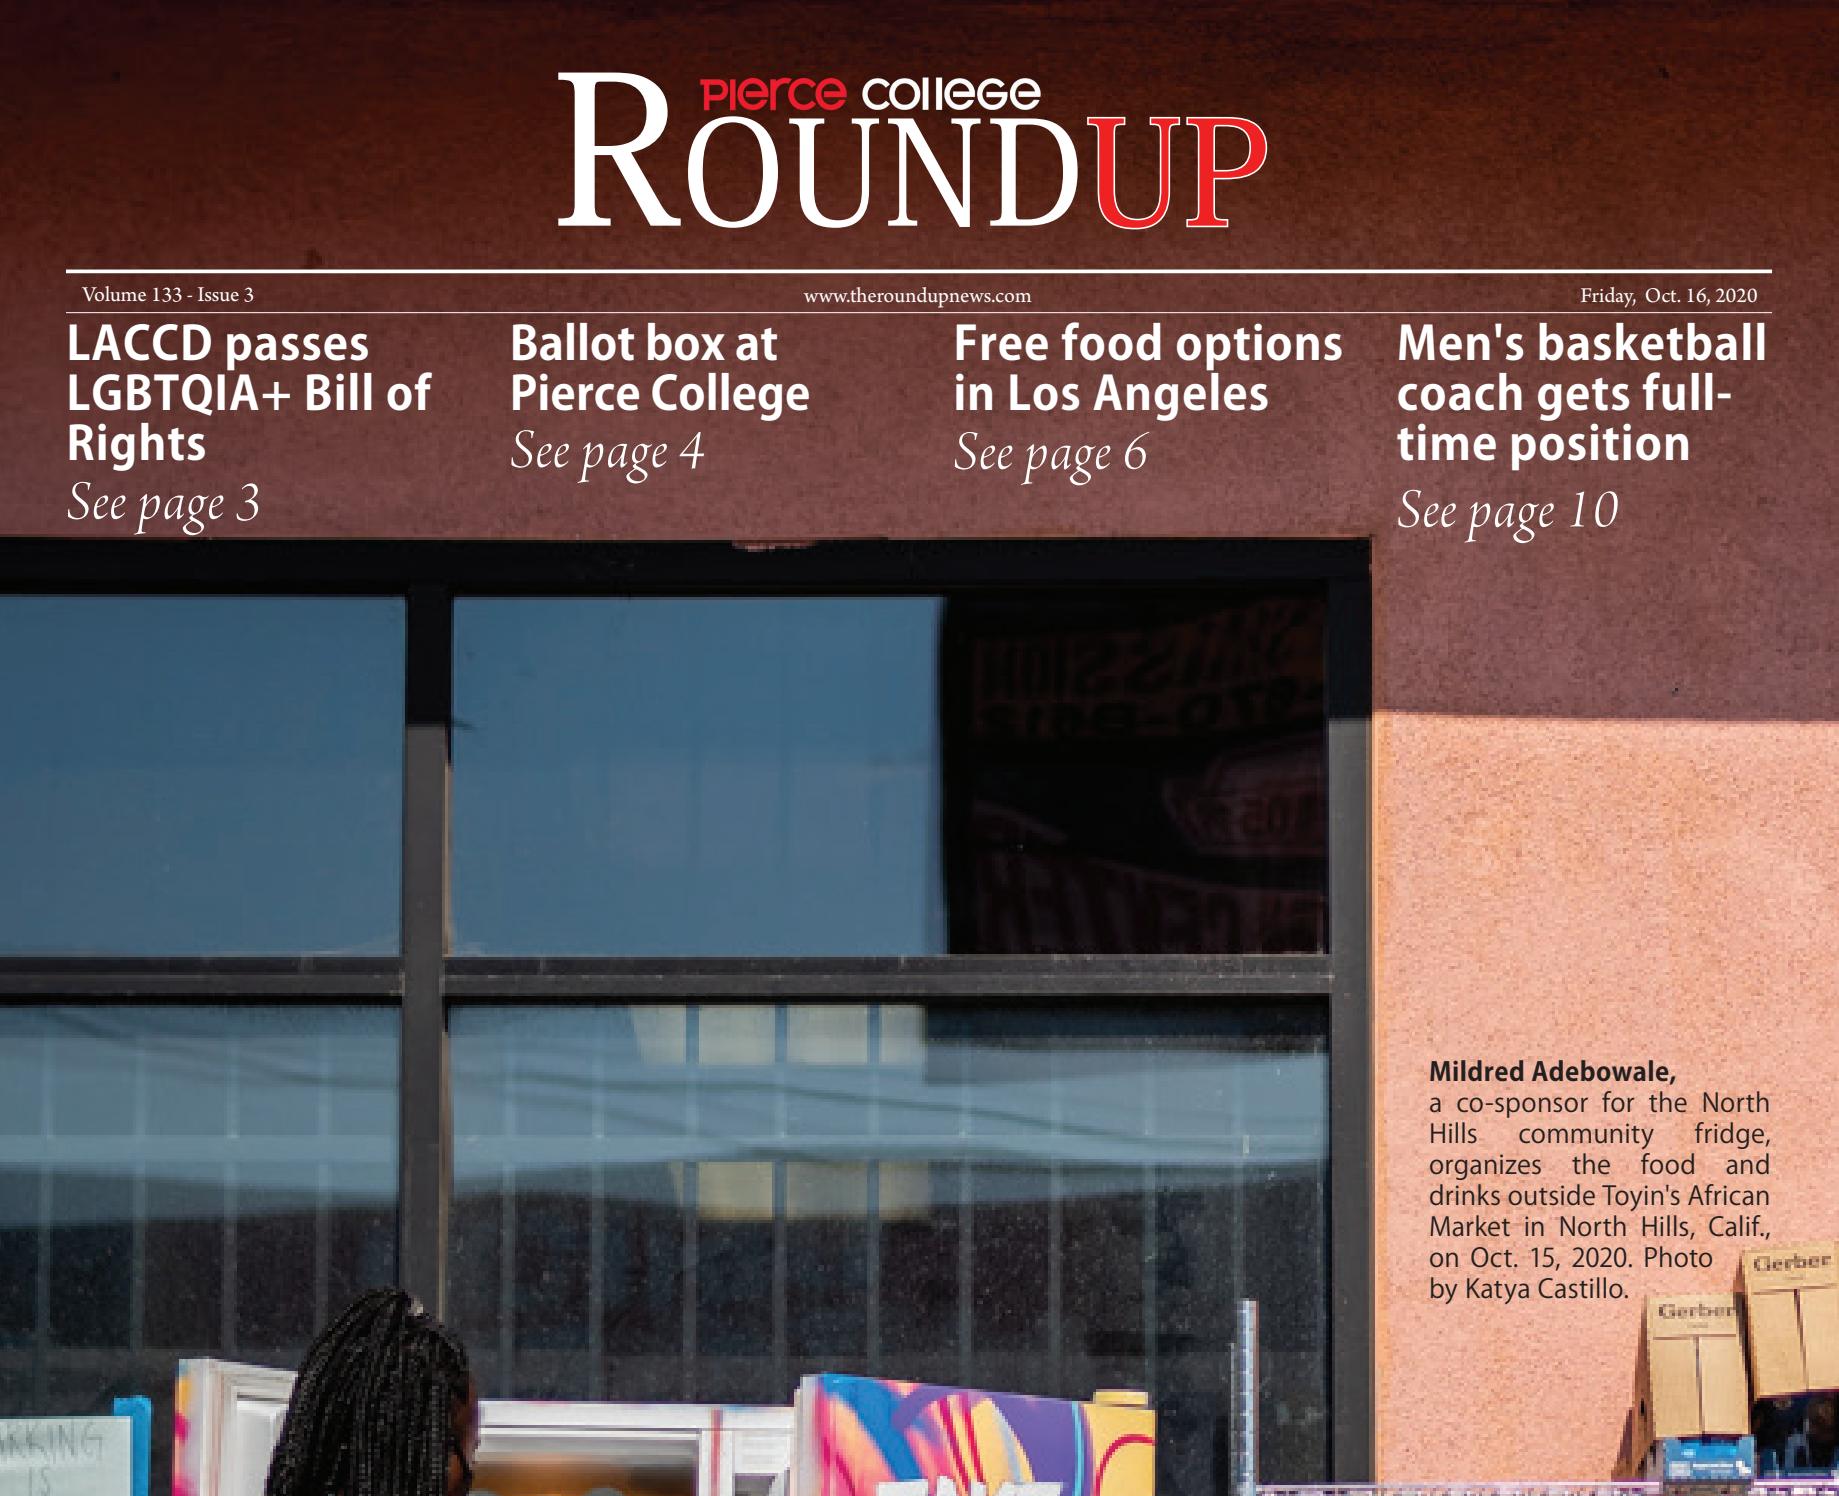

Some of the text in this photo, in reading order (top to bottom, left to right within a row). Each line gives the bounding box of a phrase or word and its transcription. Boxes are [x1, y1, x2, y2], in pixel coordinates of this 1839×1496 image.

[1753, 1252, 1832, 1273] Gerber
[1658, 1303, 1737, 1320] Gerber
[0, 1419, 104, 1463] RKING
